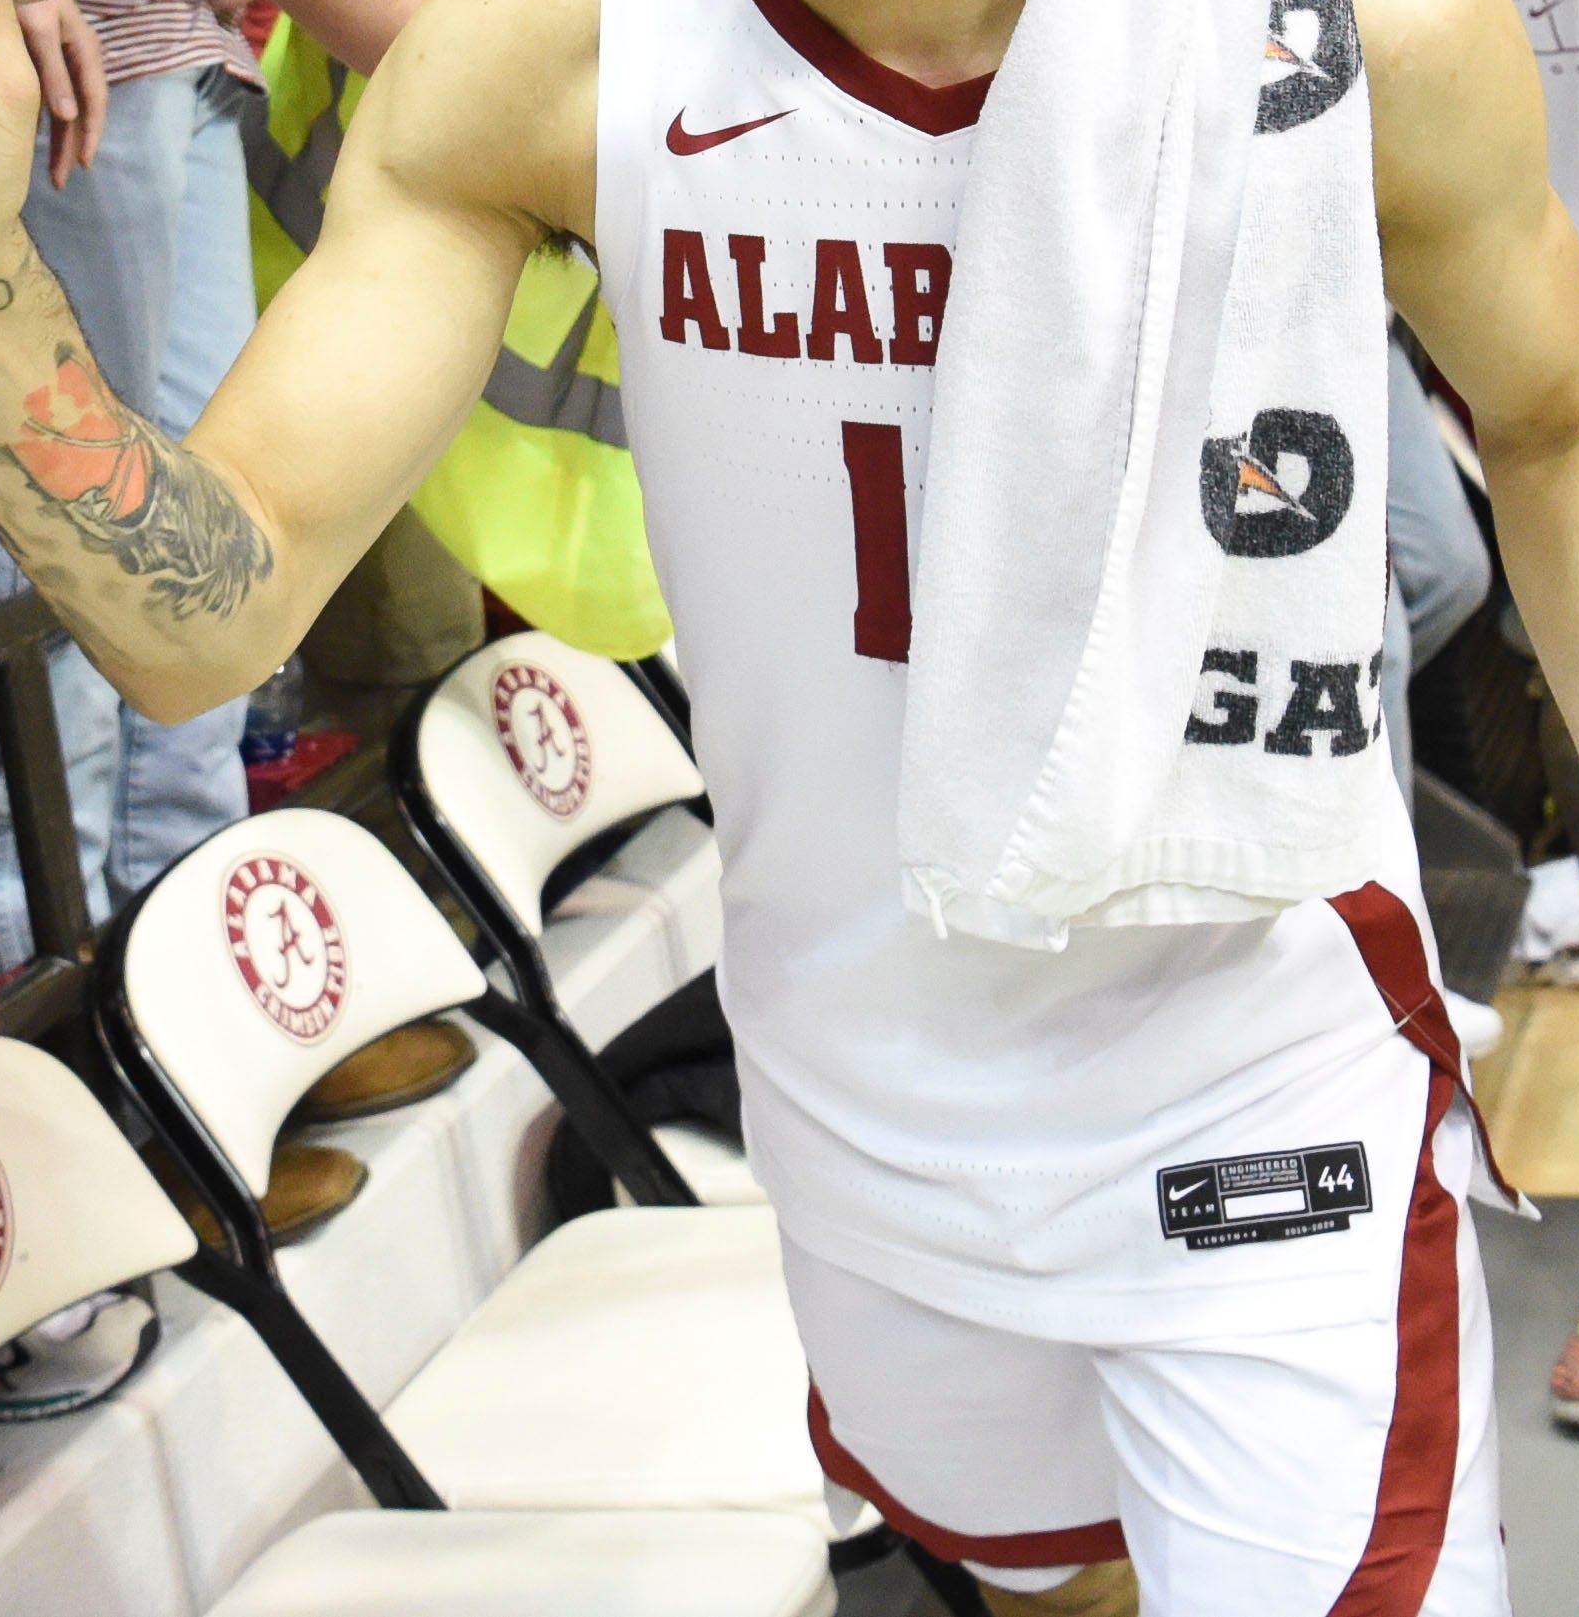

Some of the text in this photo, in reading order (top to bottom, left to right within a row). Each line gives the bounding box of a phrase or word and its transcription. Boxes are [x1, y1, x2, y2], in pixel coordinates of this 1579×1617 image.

[841, 419, 915, 665] 1
[268, 898, 315, 988] A
[1317, 1163, 1355, 1194] 44
[1170, 1203, 1216, 1218] TEAM
